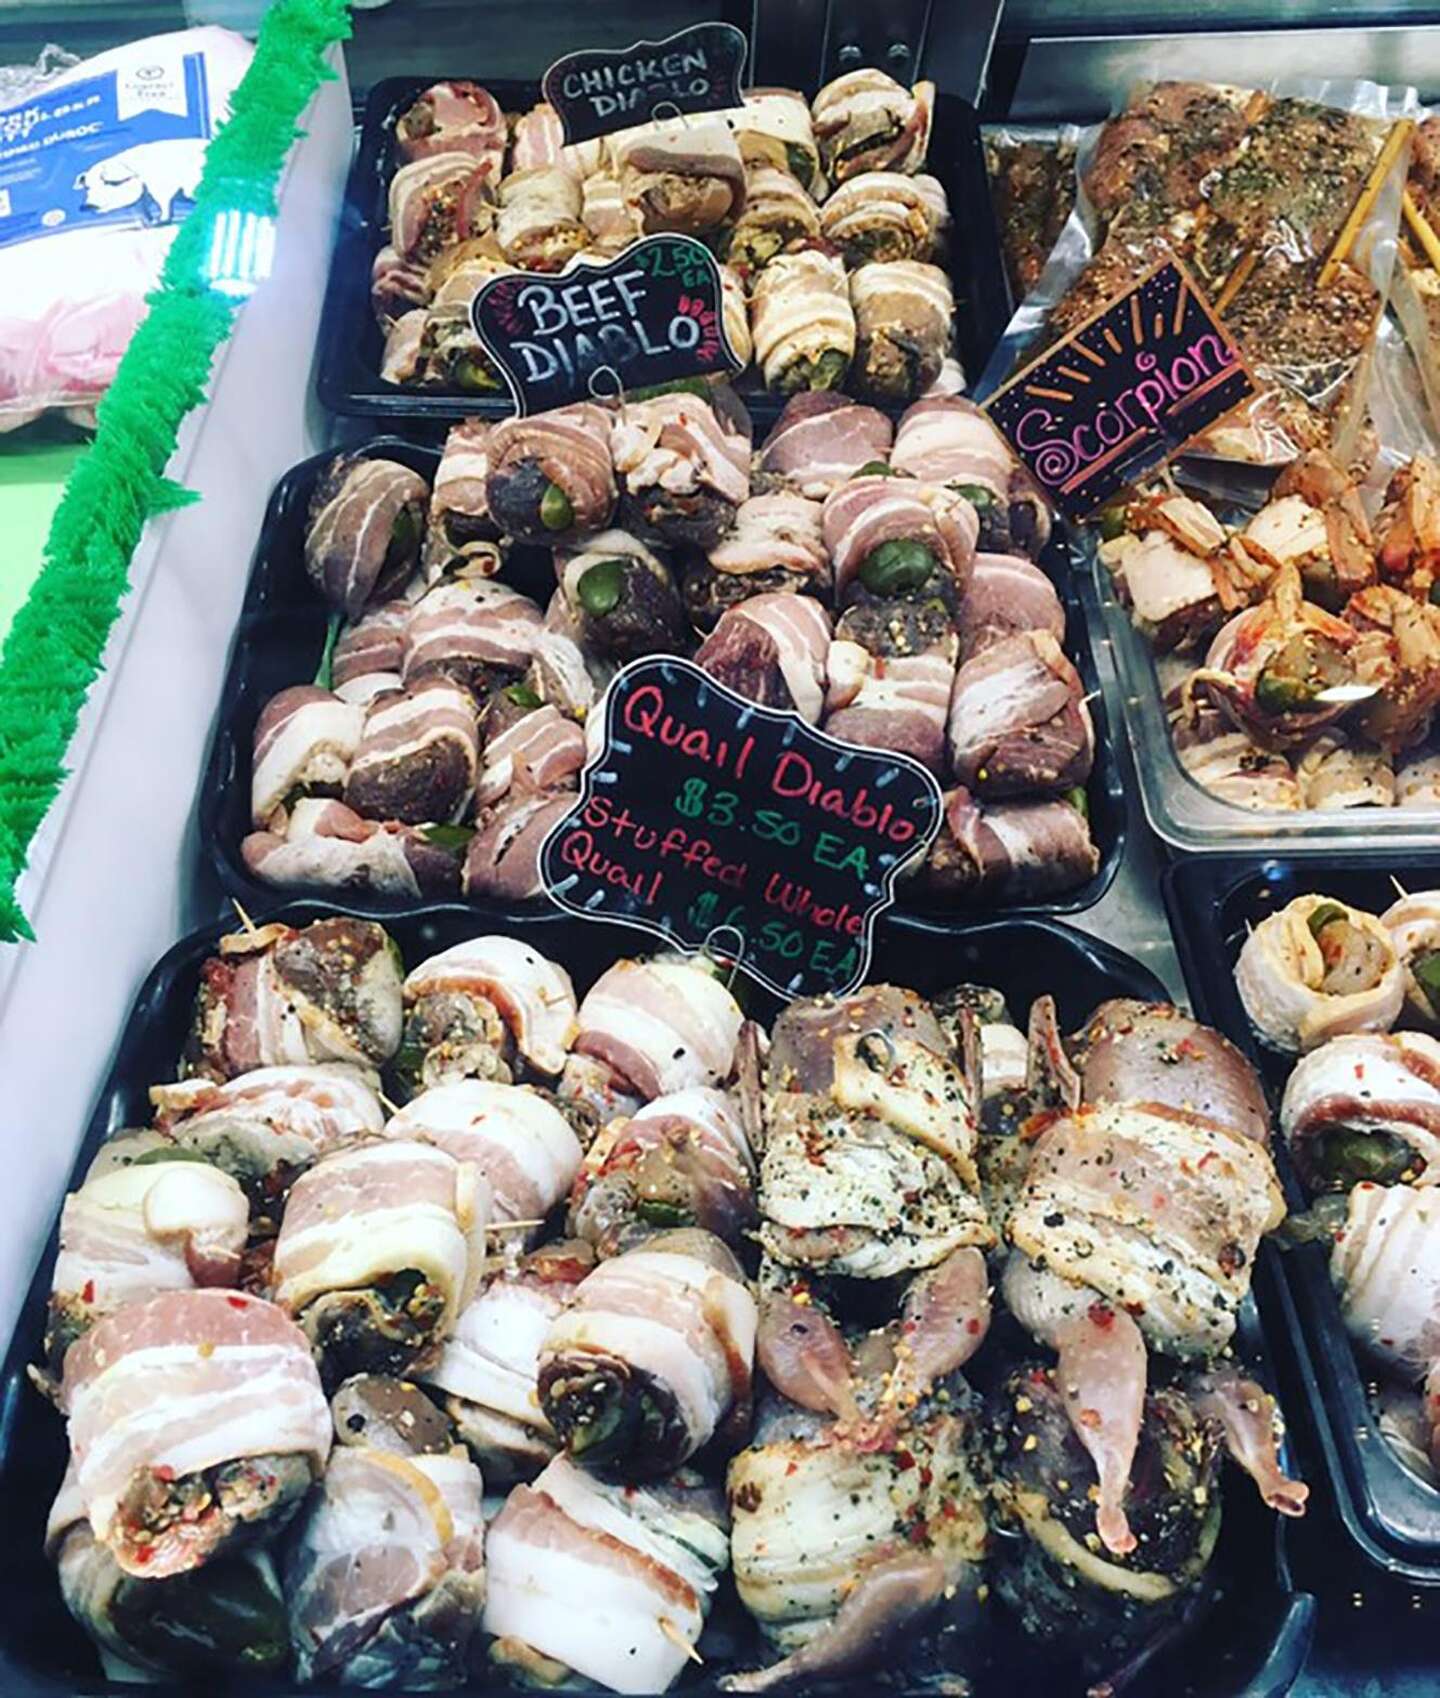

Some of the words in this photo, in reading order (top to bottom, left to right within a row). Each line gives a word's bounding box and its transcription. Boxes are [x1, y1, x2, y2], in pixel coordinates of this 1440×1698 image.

[563, 48, 708, 98] CHICKEN
[517, 270, 647, 336] BEEF
[682, 268, 712, 289] EA
[1016, 334, 1237, 487] Scorpion
[623, 685, 757, 780] Quail
[770, 750, 917, 843] Diablo
[583, 795, 749, 888] Stuffed
[763, 871, 864, 937] Whole
[674, 776, 801, 848] $3.50
[812, 834, 870, 881] EA
[560, 830, 664, 906] Quail
[809, 939, 859, 981] EA
